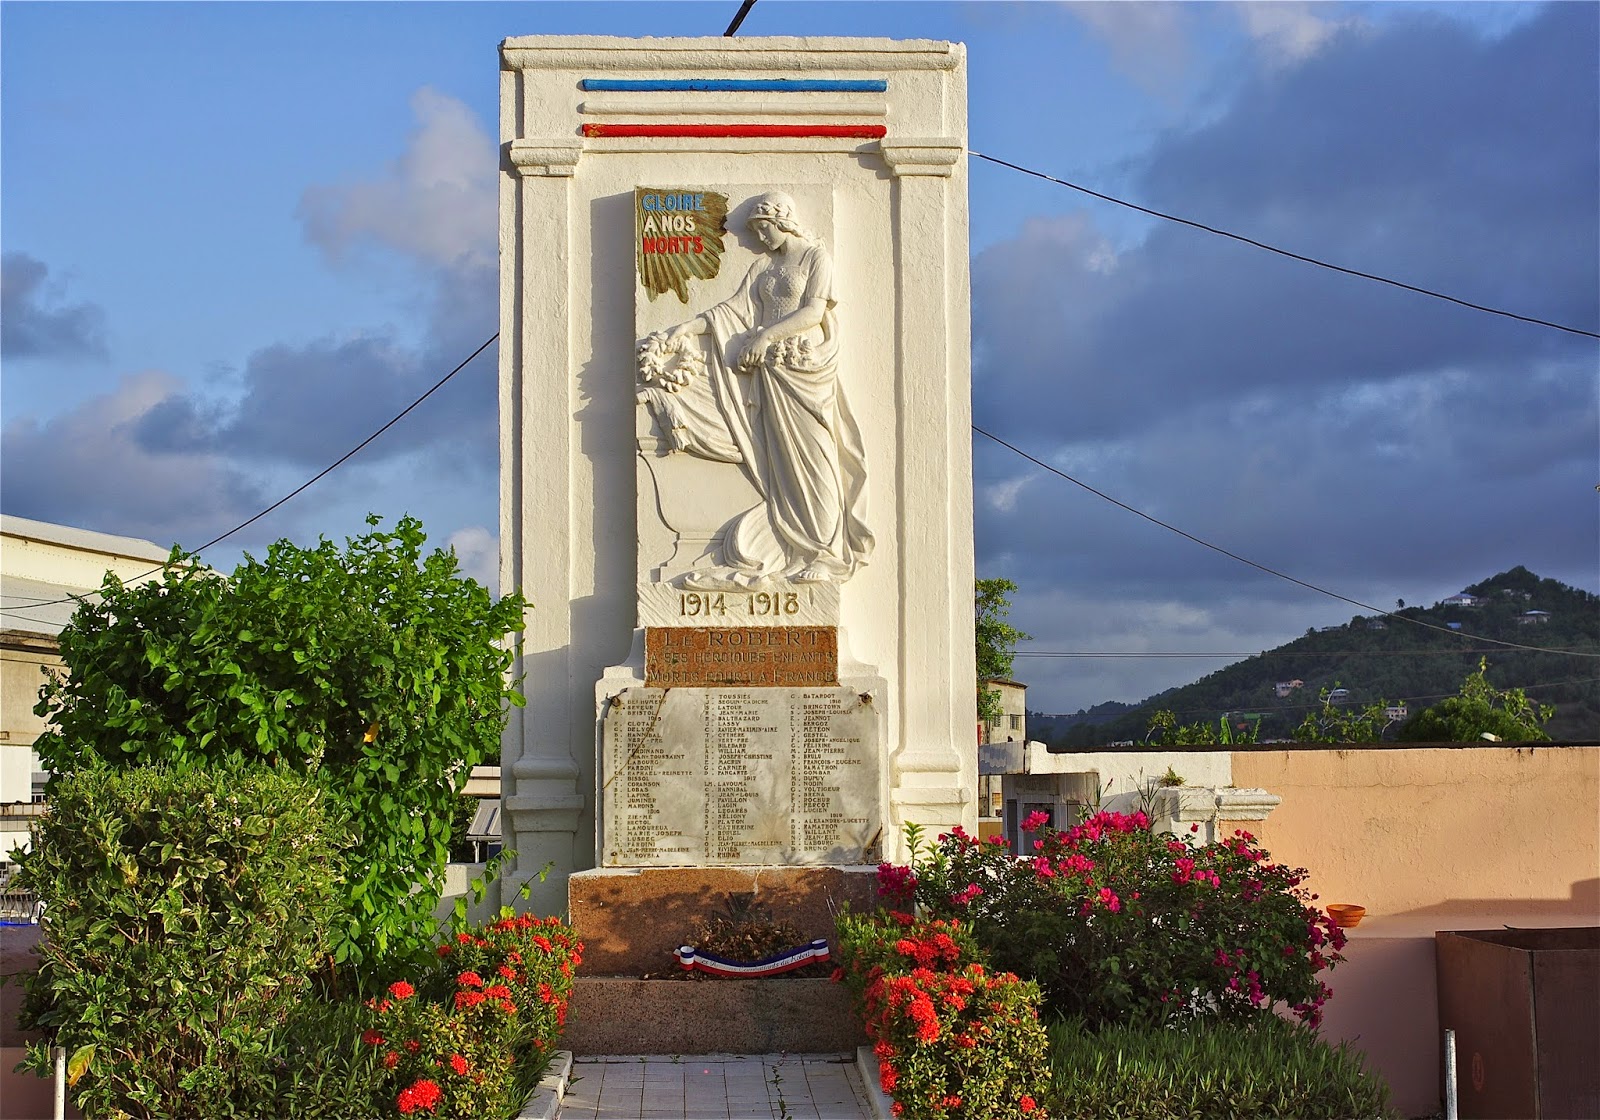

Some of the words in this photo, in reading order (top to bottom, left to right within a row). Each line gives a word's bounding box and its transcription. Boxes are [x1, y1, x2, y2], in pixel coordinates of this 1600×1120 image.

[643, 194, 705, 211] GLOIRE
[644, 215, 658, 233] A
[661, 215, 696, 233] NOS
[642, 235, 705, 255] MORTS
[680, 592, 727, 616] 1914
[748, 592, 800, 616] 1918
[708, 631, 821, 647] ROBERT
[664, 652, 688, 663] SES
[772, 652, 834, 663] ENFANTS
[650, 670, 700, 682] MORTS
[706, 671, 742, 683] POUR
[750, 671, 767, 683] LA
[773, 669, 834, 683] FRANCE
